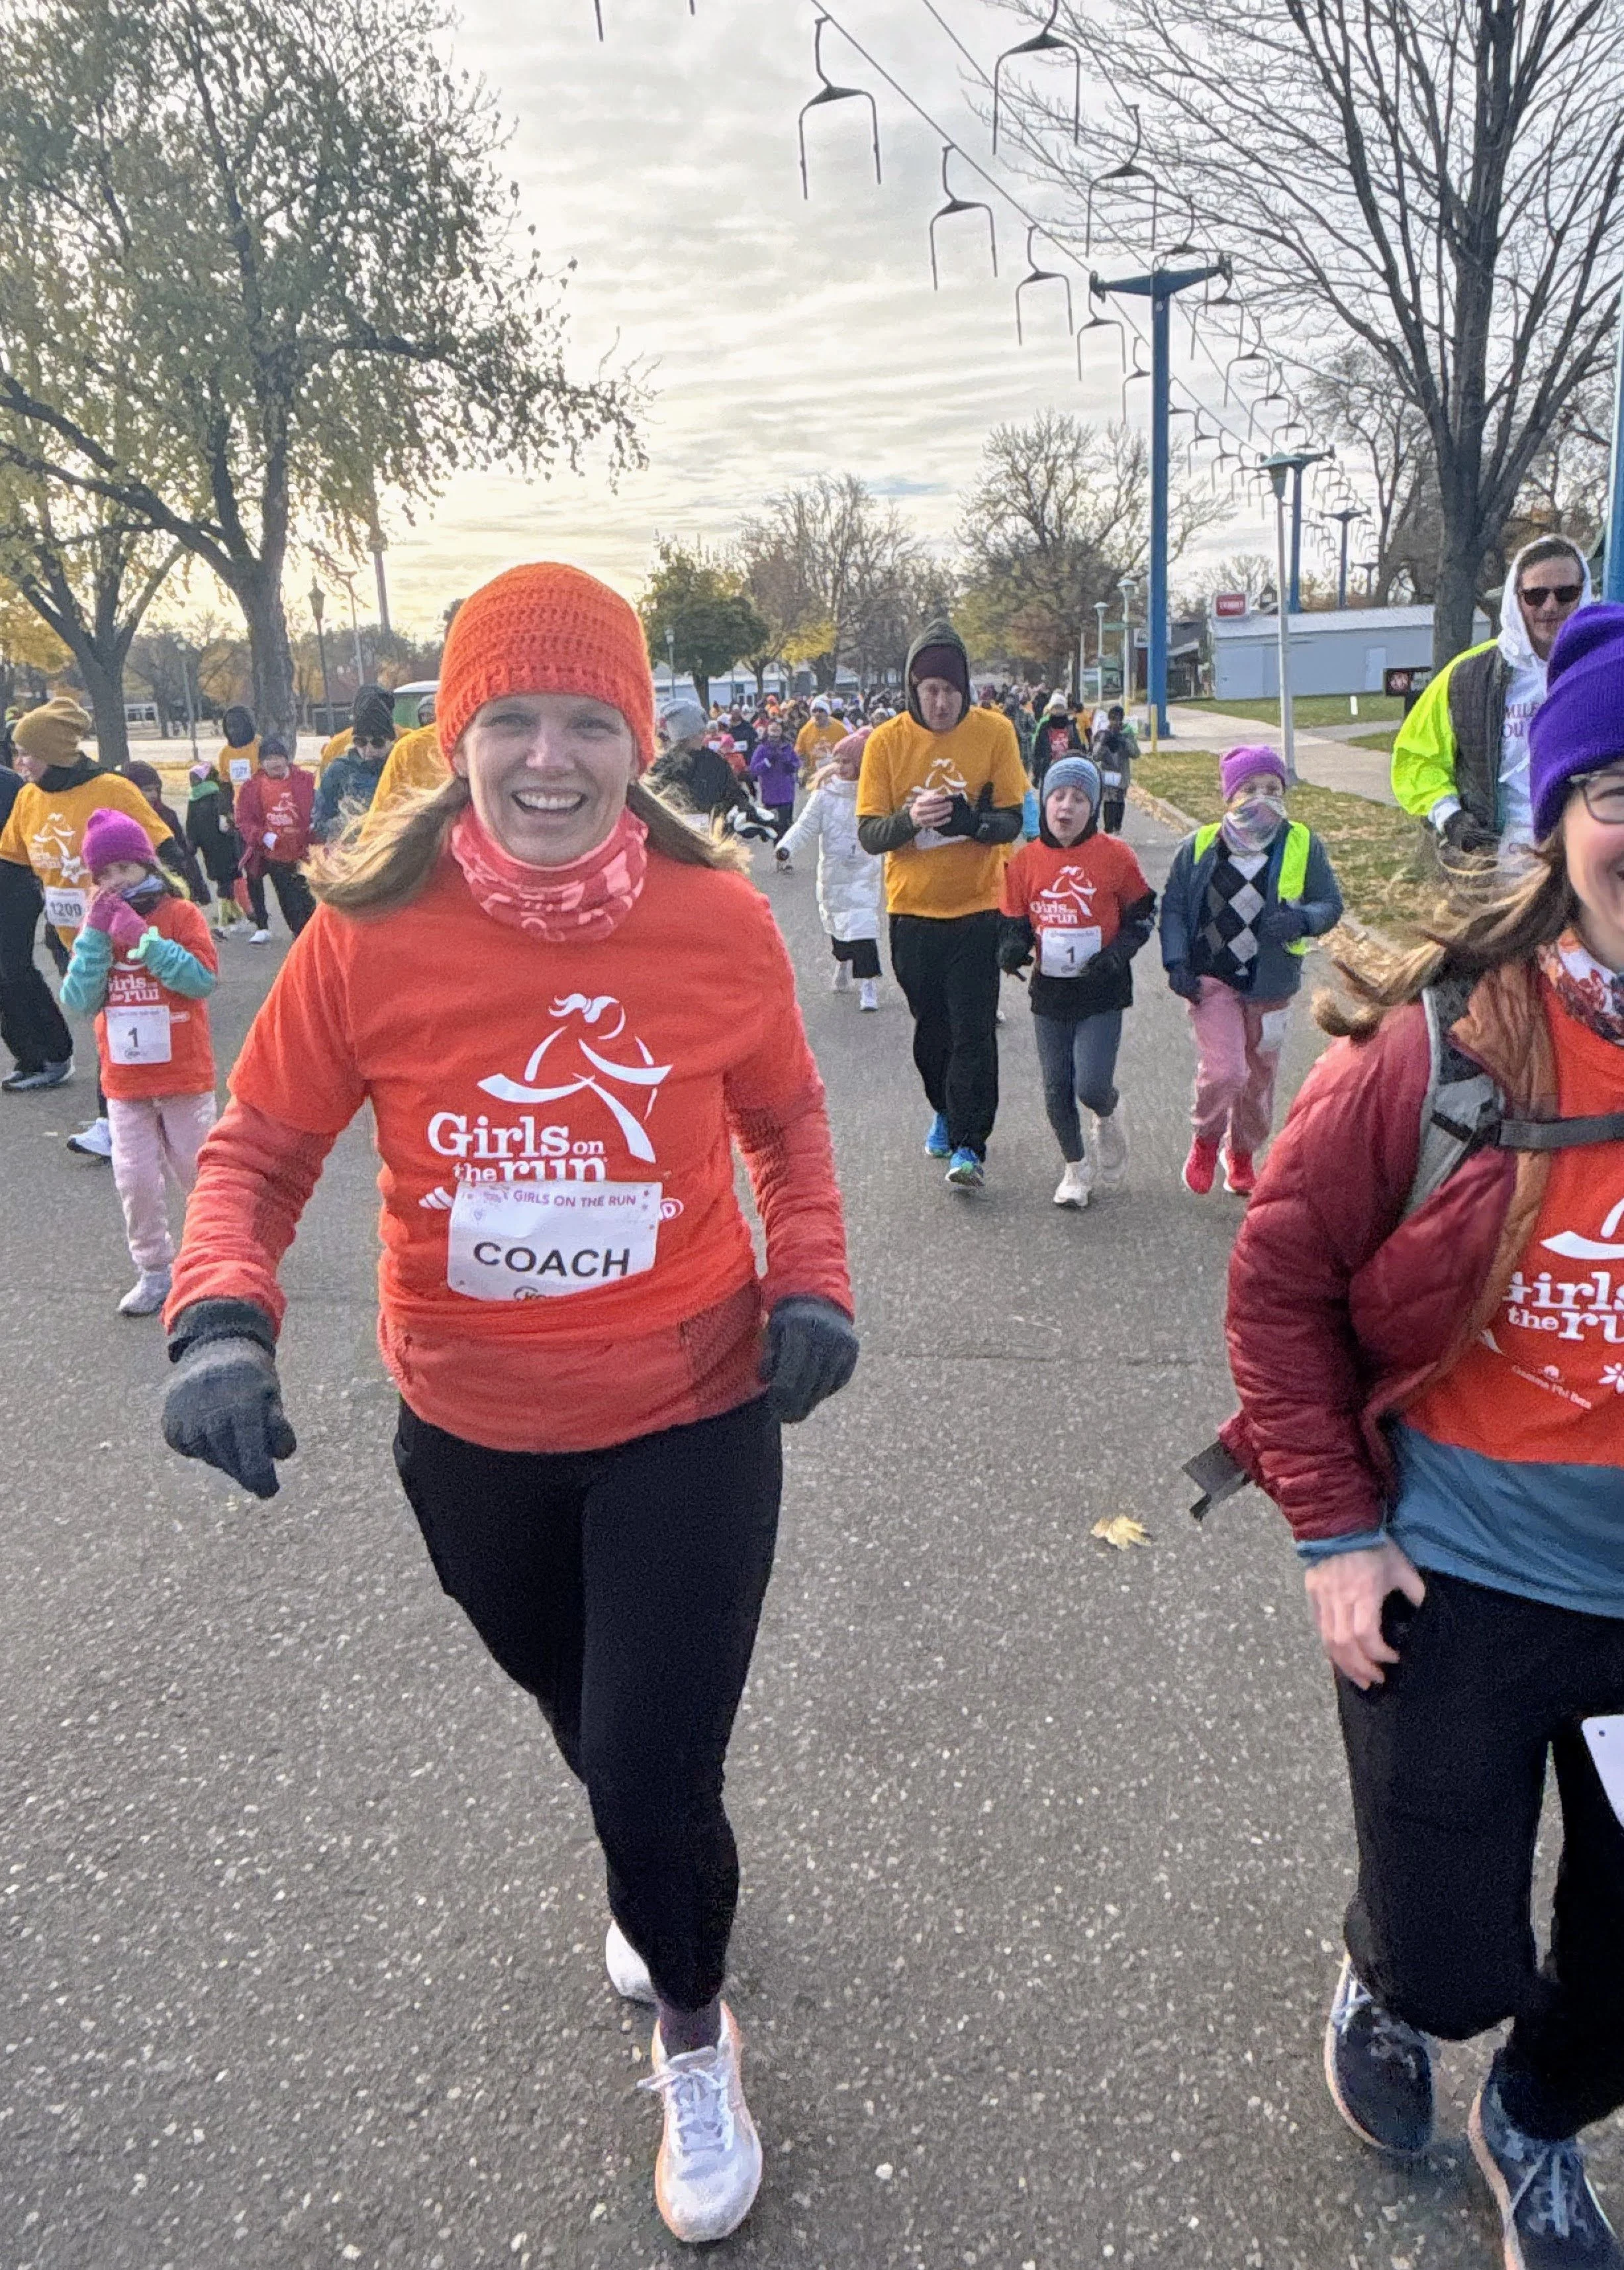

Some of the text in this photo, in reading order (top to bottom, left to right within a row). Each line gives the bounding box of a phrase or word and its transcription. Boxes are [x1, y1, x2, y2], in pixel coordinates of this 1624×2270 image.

[1066, 946, 1075, 964] 1
[127, 1027, 139, 1048] 1
[428, 1111, 605, 1158] Girls on
[453, 1157, 607, 1182] the run
[513, 1189, 550, 1205] GIRLS
[553, 1195, 577, 1208] ON
[580, 1197, 605, 1208] THE
[608, 1194, 636, 1207] RUN
[473, 1241, 630, 1278] COACH
[1508, 1305, 1559, 1331] the
